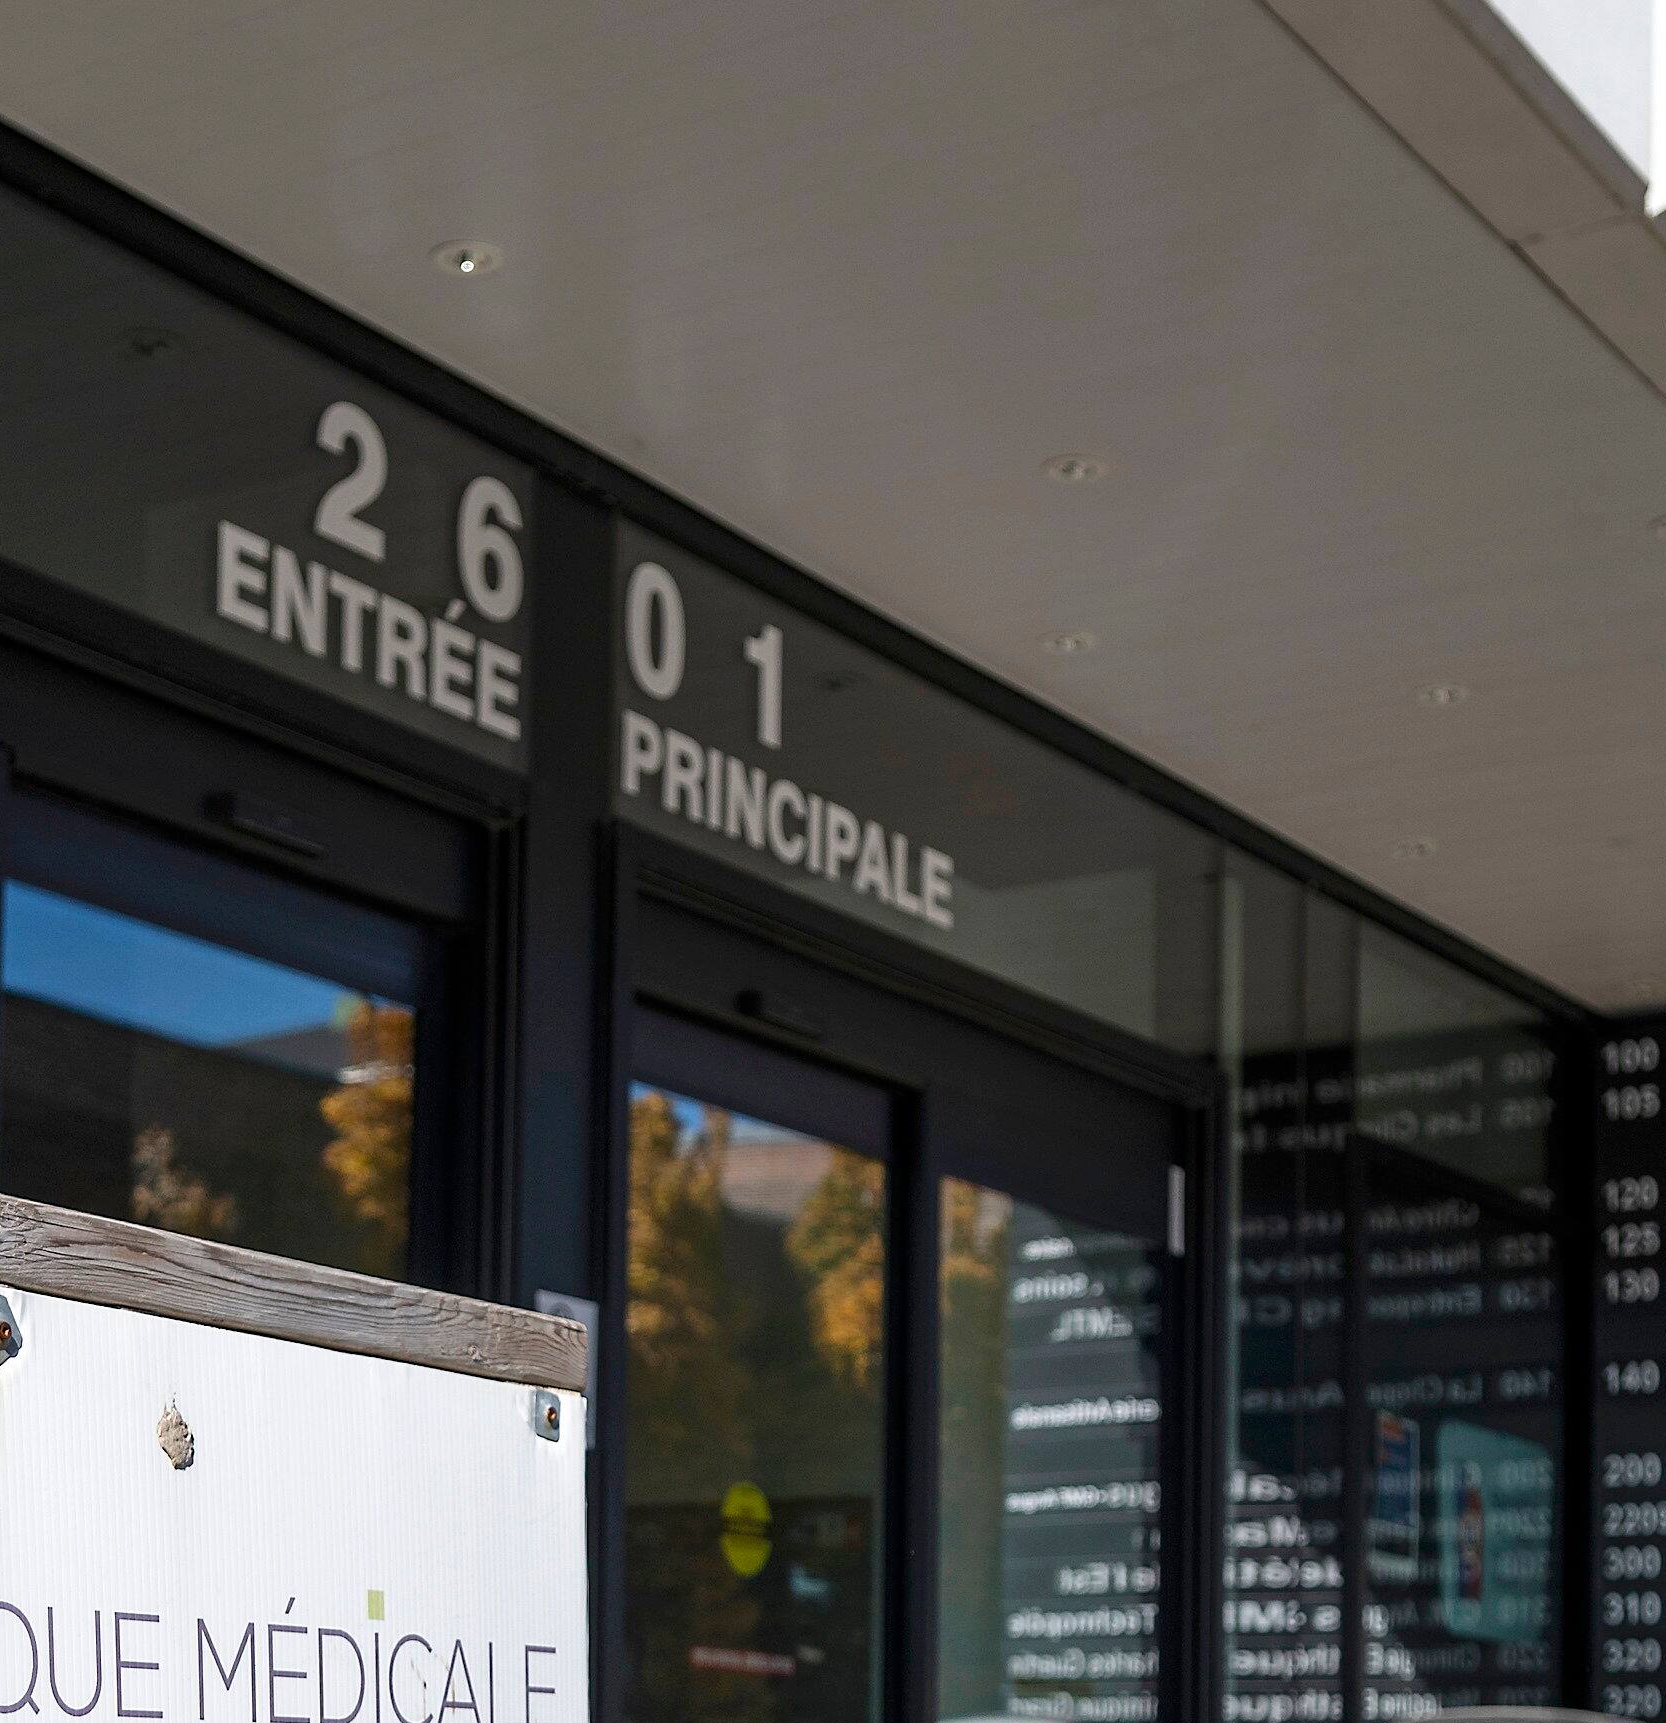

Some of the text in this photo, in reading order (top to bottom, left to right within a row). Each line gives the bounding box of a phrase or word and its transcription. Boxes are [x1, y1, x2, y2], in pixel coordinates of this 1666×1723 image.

[216, 520, 954, 928] ENTRÉE PRINCIPALE
[1601, 1037, 1661, 1073] 100
[1601, 1084, 1661, 1120] 105
[1601, 1267, 1661, 1304] 130
[1601, 1360, 1661, 1396] 140
[1602, 1452, 1662, 1487] 200
